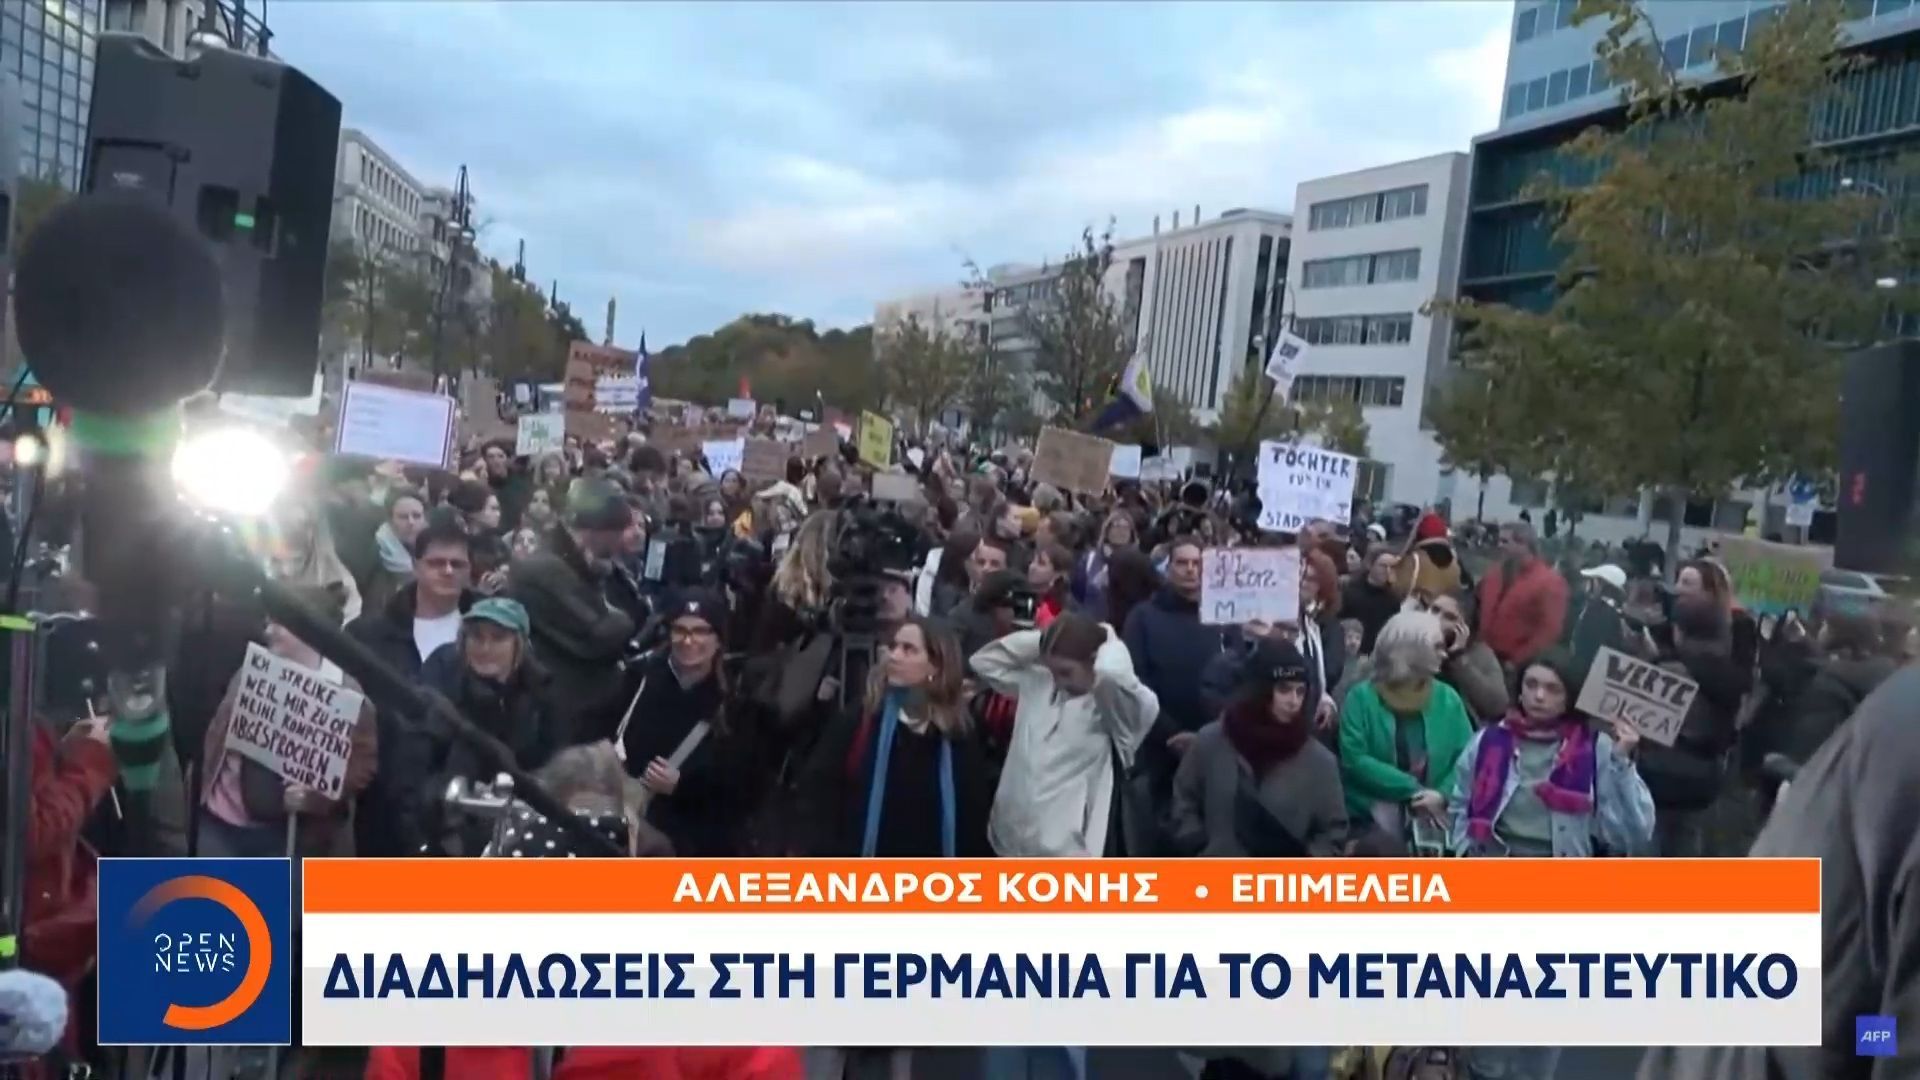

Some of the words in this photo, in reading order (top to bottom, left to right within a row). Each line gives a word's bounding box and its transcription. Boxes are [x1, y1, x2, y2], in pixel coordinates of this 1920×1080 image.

[245, 673, 278, 704] WEIL
[283, 692, 309, 717] MIR
[310, 705, 330, 727] ZU
[1606, 655, 1696, 707] WERTE
[239, 693, 277, 724] MEINE
[230, 714, 330, 776] ABGESPROCHEN
